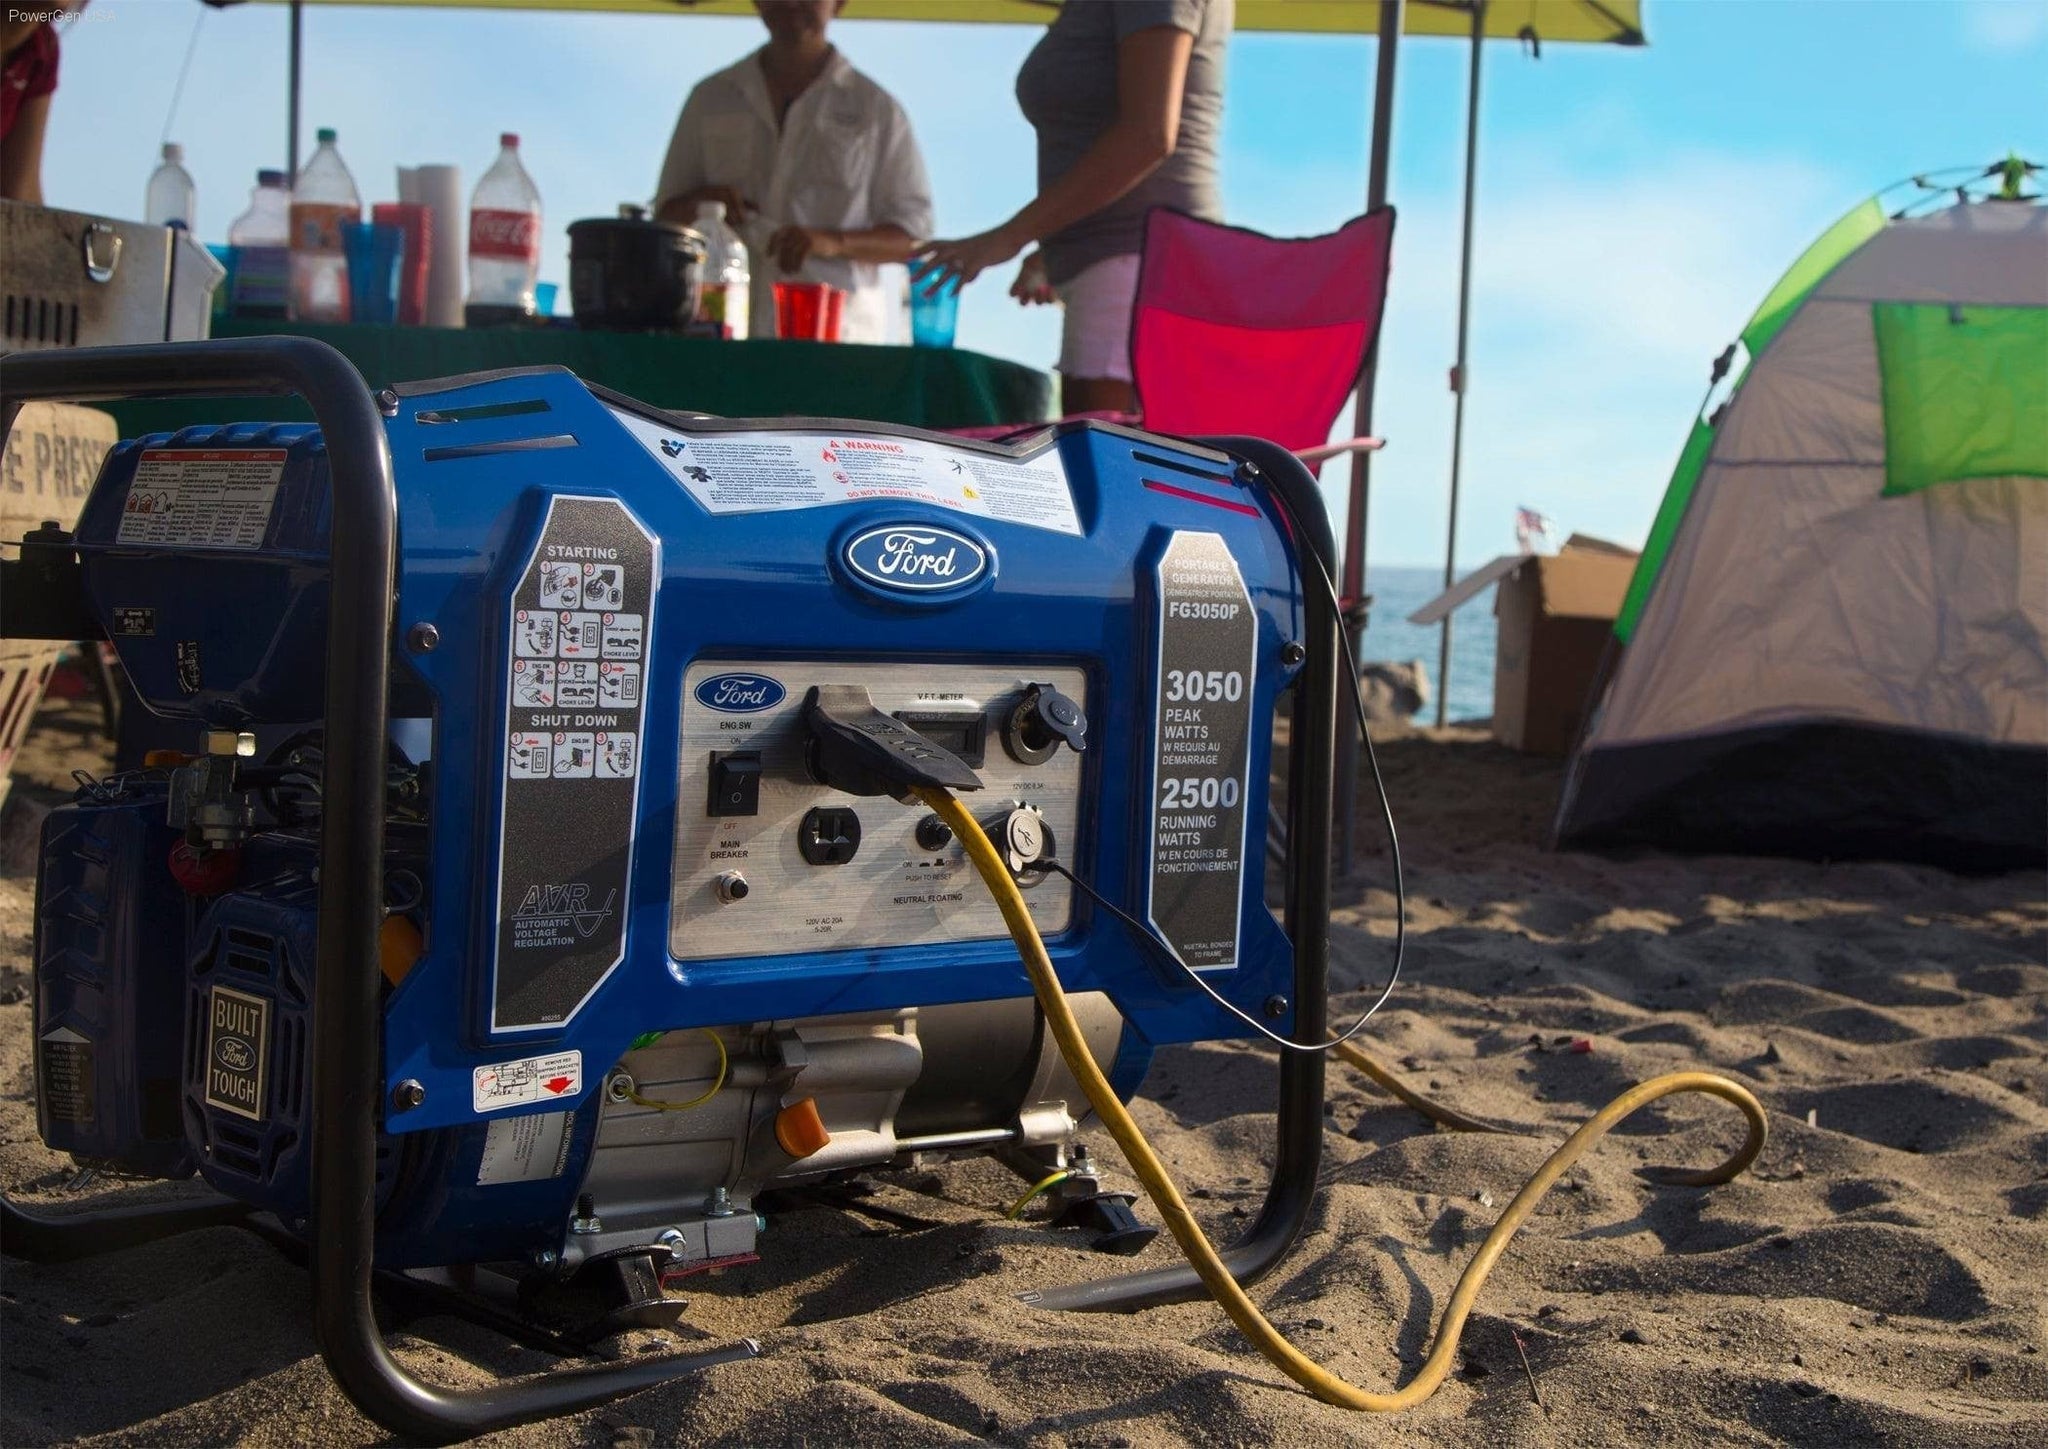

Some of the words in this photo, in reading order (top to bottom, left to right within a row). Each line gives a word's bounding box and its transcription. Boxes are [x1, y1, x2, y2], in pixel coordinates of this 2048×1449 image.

[843, 440, 904, 454] WARNING
[861, 489, 876, 497] NOT
[879, 488, 914, 497] REMOVE
[547, 545, 618, 560] STARTING
[877, 533, 956, 576] Ford
[1169, 601, 1240, 620] FG3050P
[714, 678, 766, 704] Ford
[1166, 669, 1243, 702] 3050
[531, 714, 571, 727] SHUT
[574, 715, 618, 727] DOWN
[1165, 708, 1202, 722] PEAK
[1164, 725, 1209, 739] WATTS
[1163, 742, 1172, 752] W
[1173, 742, 1207, 752] REQUIS
[1207, 742, 1221, 752] AU
[1160, 776, 1240, 809] 2500
[1160, 814, 1218, 830] RUNNING
[720, 840, 740, 849] MAIN
[1158, 831, 1202, 847] WATTS
[710, 851, 749, 860] BREAKER
[1158, 850, 1168, 861] W
[1169, 850, 1182, 861] EN
[1183, 850, 1215, 860] COURS
[1216, 849, 1229, 859] DE
[1157, 860, 1239, 874] FONCTIONNEMENT
[893, 896, 926, 905] NEUTRAL
[927, 893, 963, 903] FLOATING
[514, 918, 571, 930] AUTOMATIC
[514, 928, 558, 939] VOLTAGE
[513, 936, 575, 948] REGULATION
[216, 999, 259, 1038] BUILT
[222, 1040, 249, 1067] Ford
[213, 1068, 256, 1104] TOUGH
